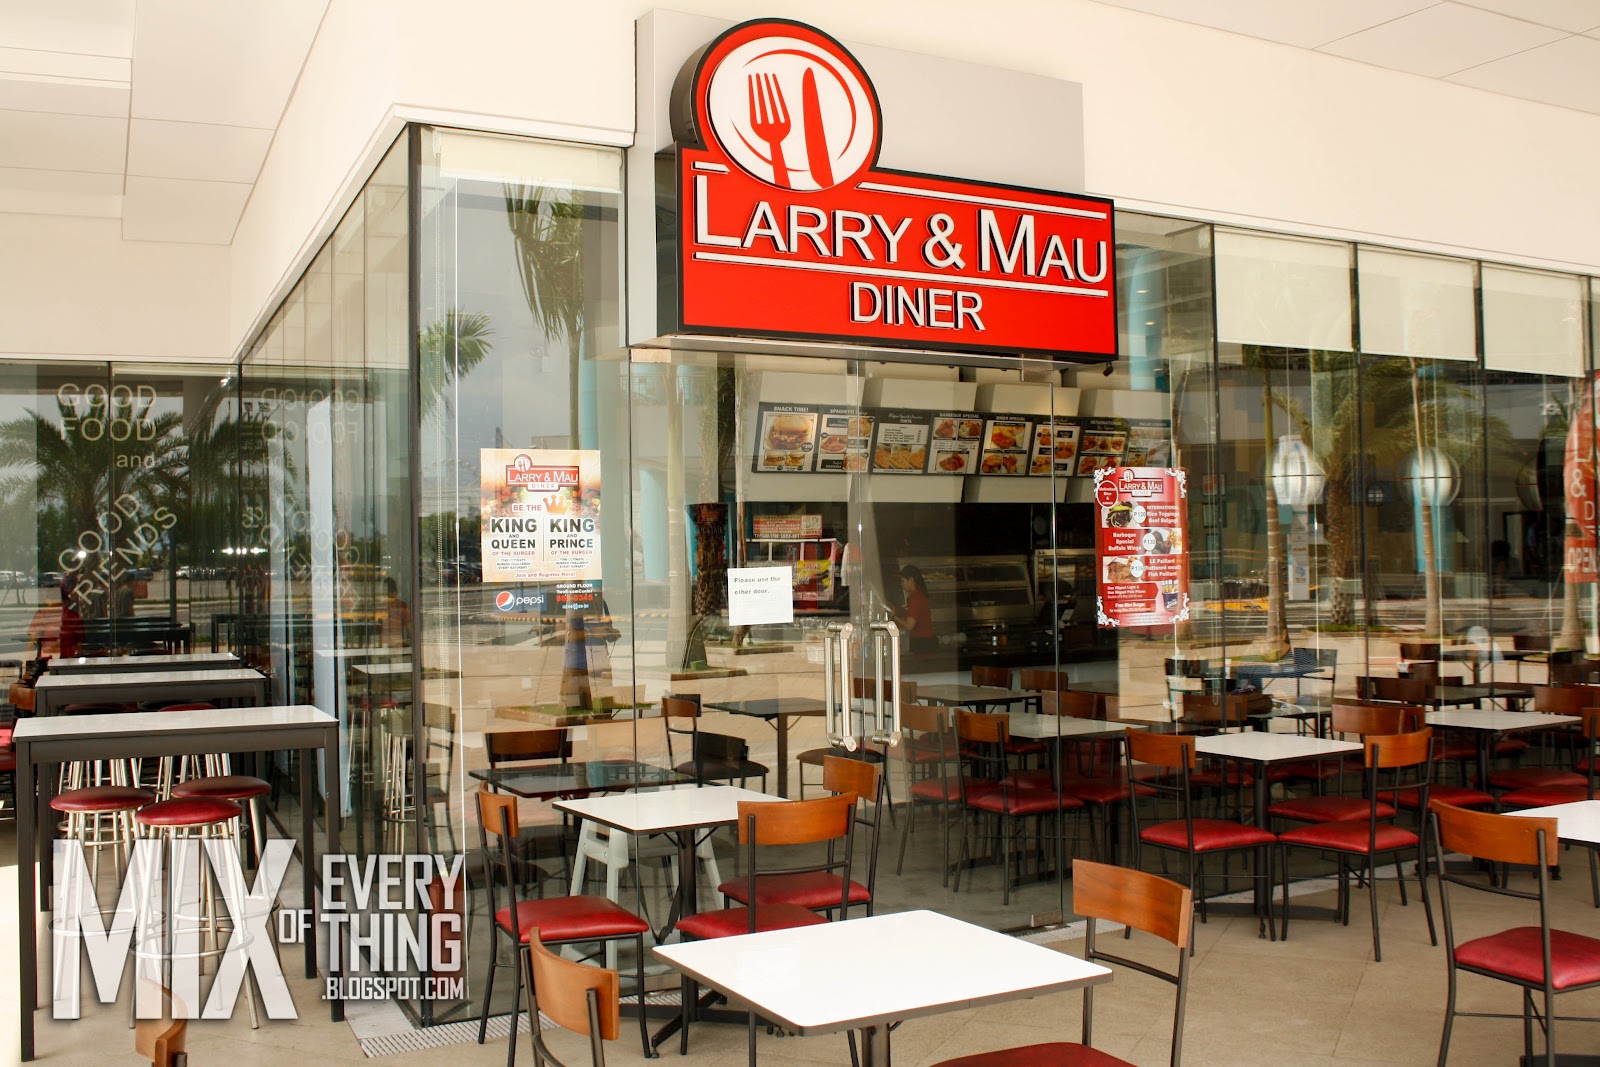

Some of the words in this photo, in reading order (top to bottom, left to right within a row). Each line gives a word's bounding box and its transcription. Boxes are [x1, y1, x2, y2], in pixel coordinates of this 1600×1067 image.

[694, 174, 912, 263] LARRY
[922, 212, 966, 270] &
[977, 209, 1108, 284] MAU
[850, 281, 986, 332] DINER
[57, 383, 157, 409] GOOD
[60, 417, 157, 442] FOOD
[116, 452, 156, 468] and
[508, 471, 542, 482] LARRY
[544, 472, 551, 482] &
[554, 471, 578, 483] MAU
[1119, 481, 1141, 490] LARRY
[1148, 482, 1163, 490] MAU
[58, 493, 140, 573] GOOD
[491, 519, 537, 533] KING
[550, 519, 595, 533] KING
[491, 539, 536, 549] QUEEN
[550, 539, 594, 548] PRINCE
[68, 506, 178, 611] RIENDS
[516, 595, 544, 606] pepsi
